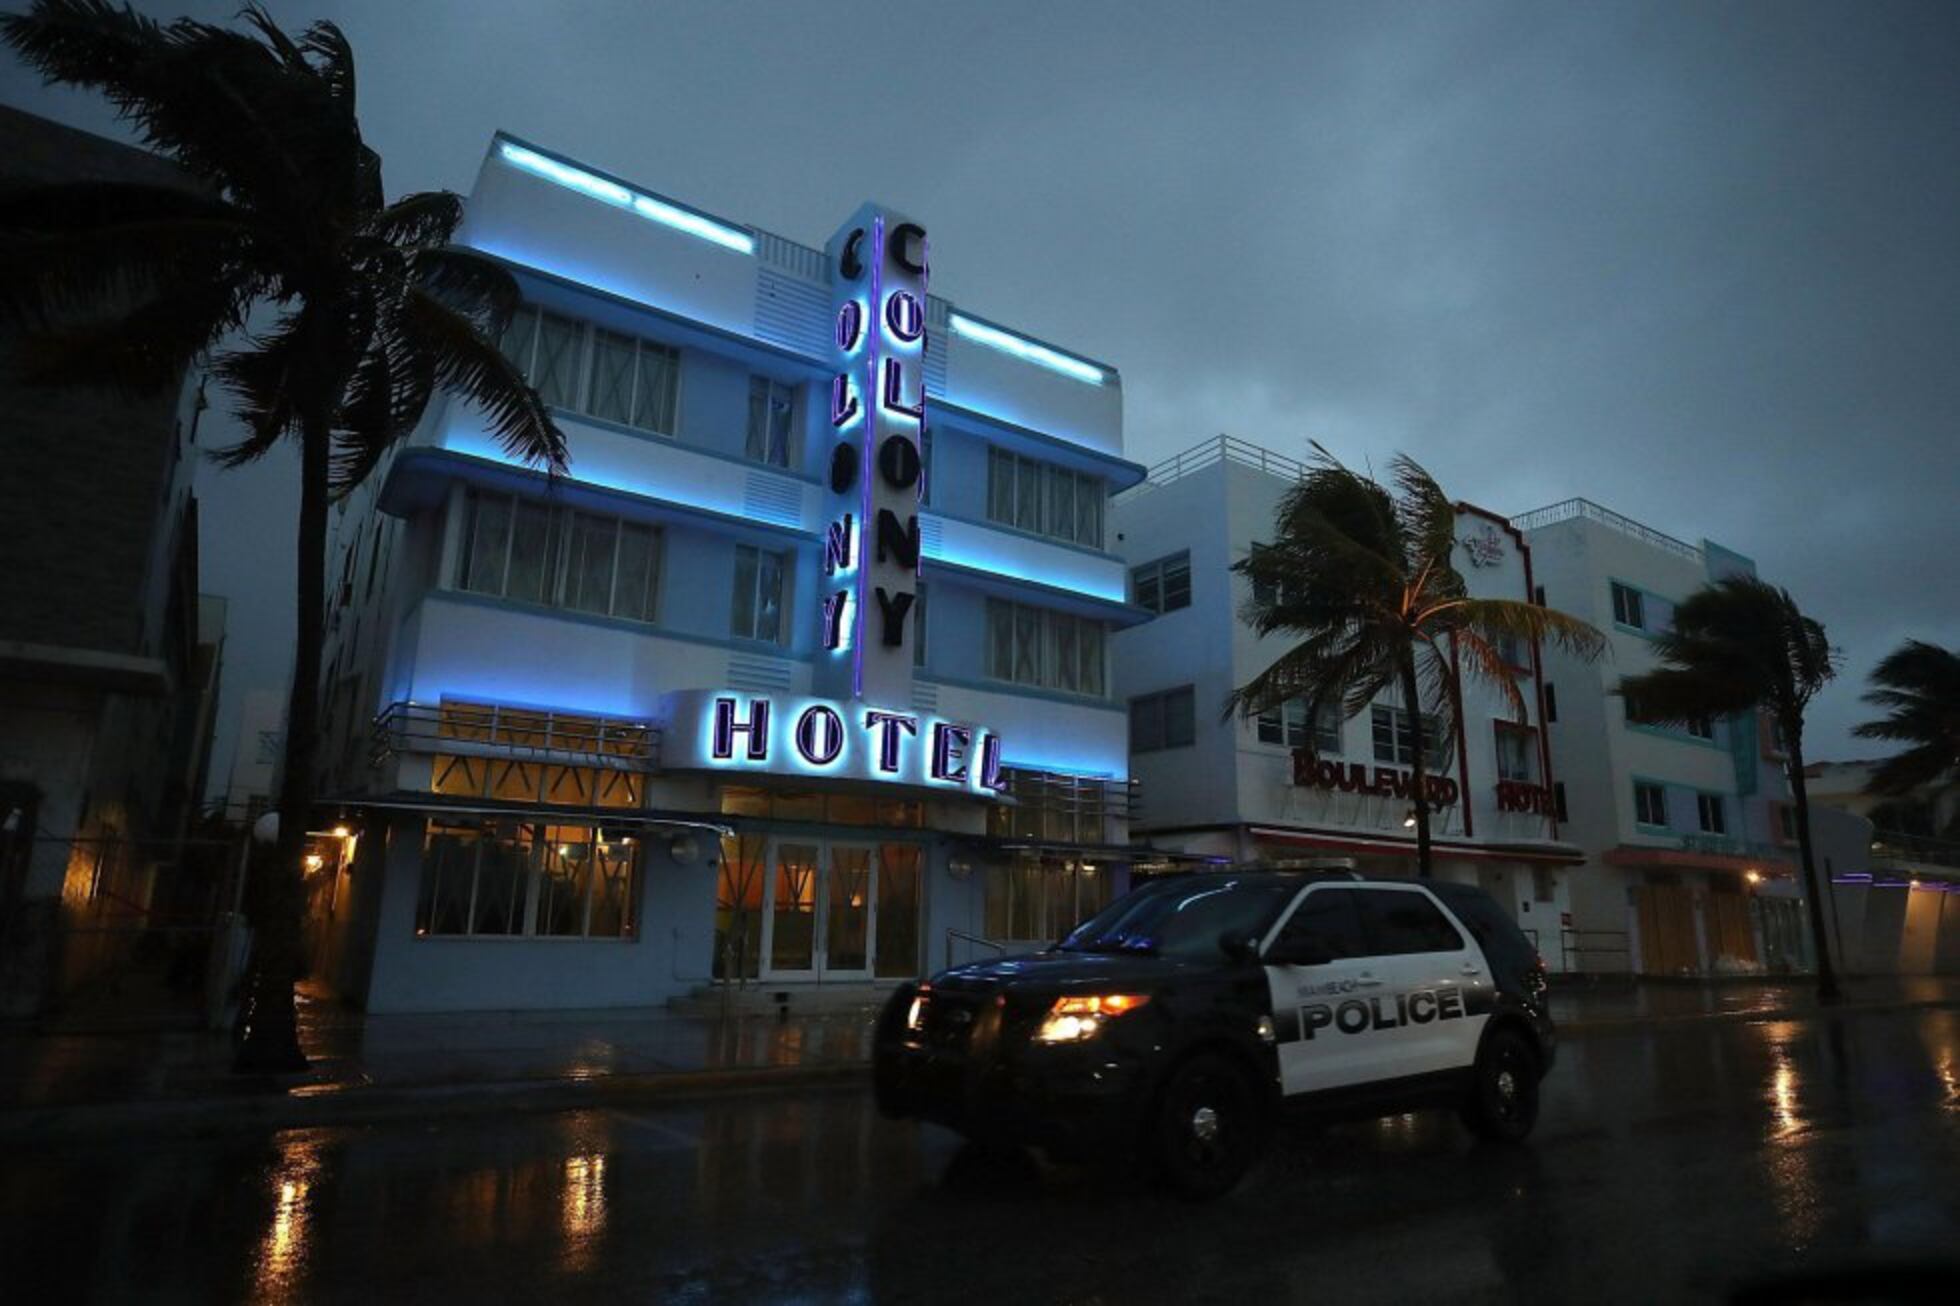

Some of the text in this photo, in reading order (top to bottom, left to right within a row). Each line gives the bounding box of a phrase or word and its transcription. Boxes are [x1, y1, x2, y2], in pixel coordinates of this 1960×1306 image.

[823, 228, 863, 650] COLONY
[875, 222, 930, 648] COLONY
[712, 698, 1006, 791] HOTEL
[1301, 987, 1462, 1040] POLICE
